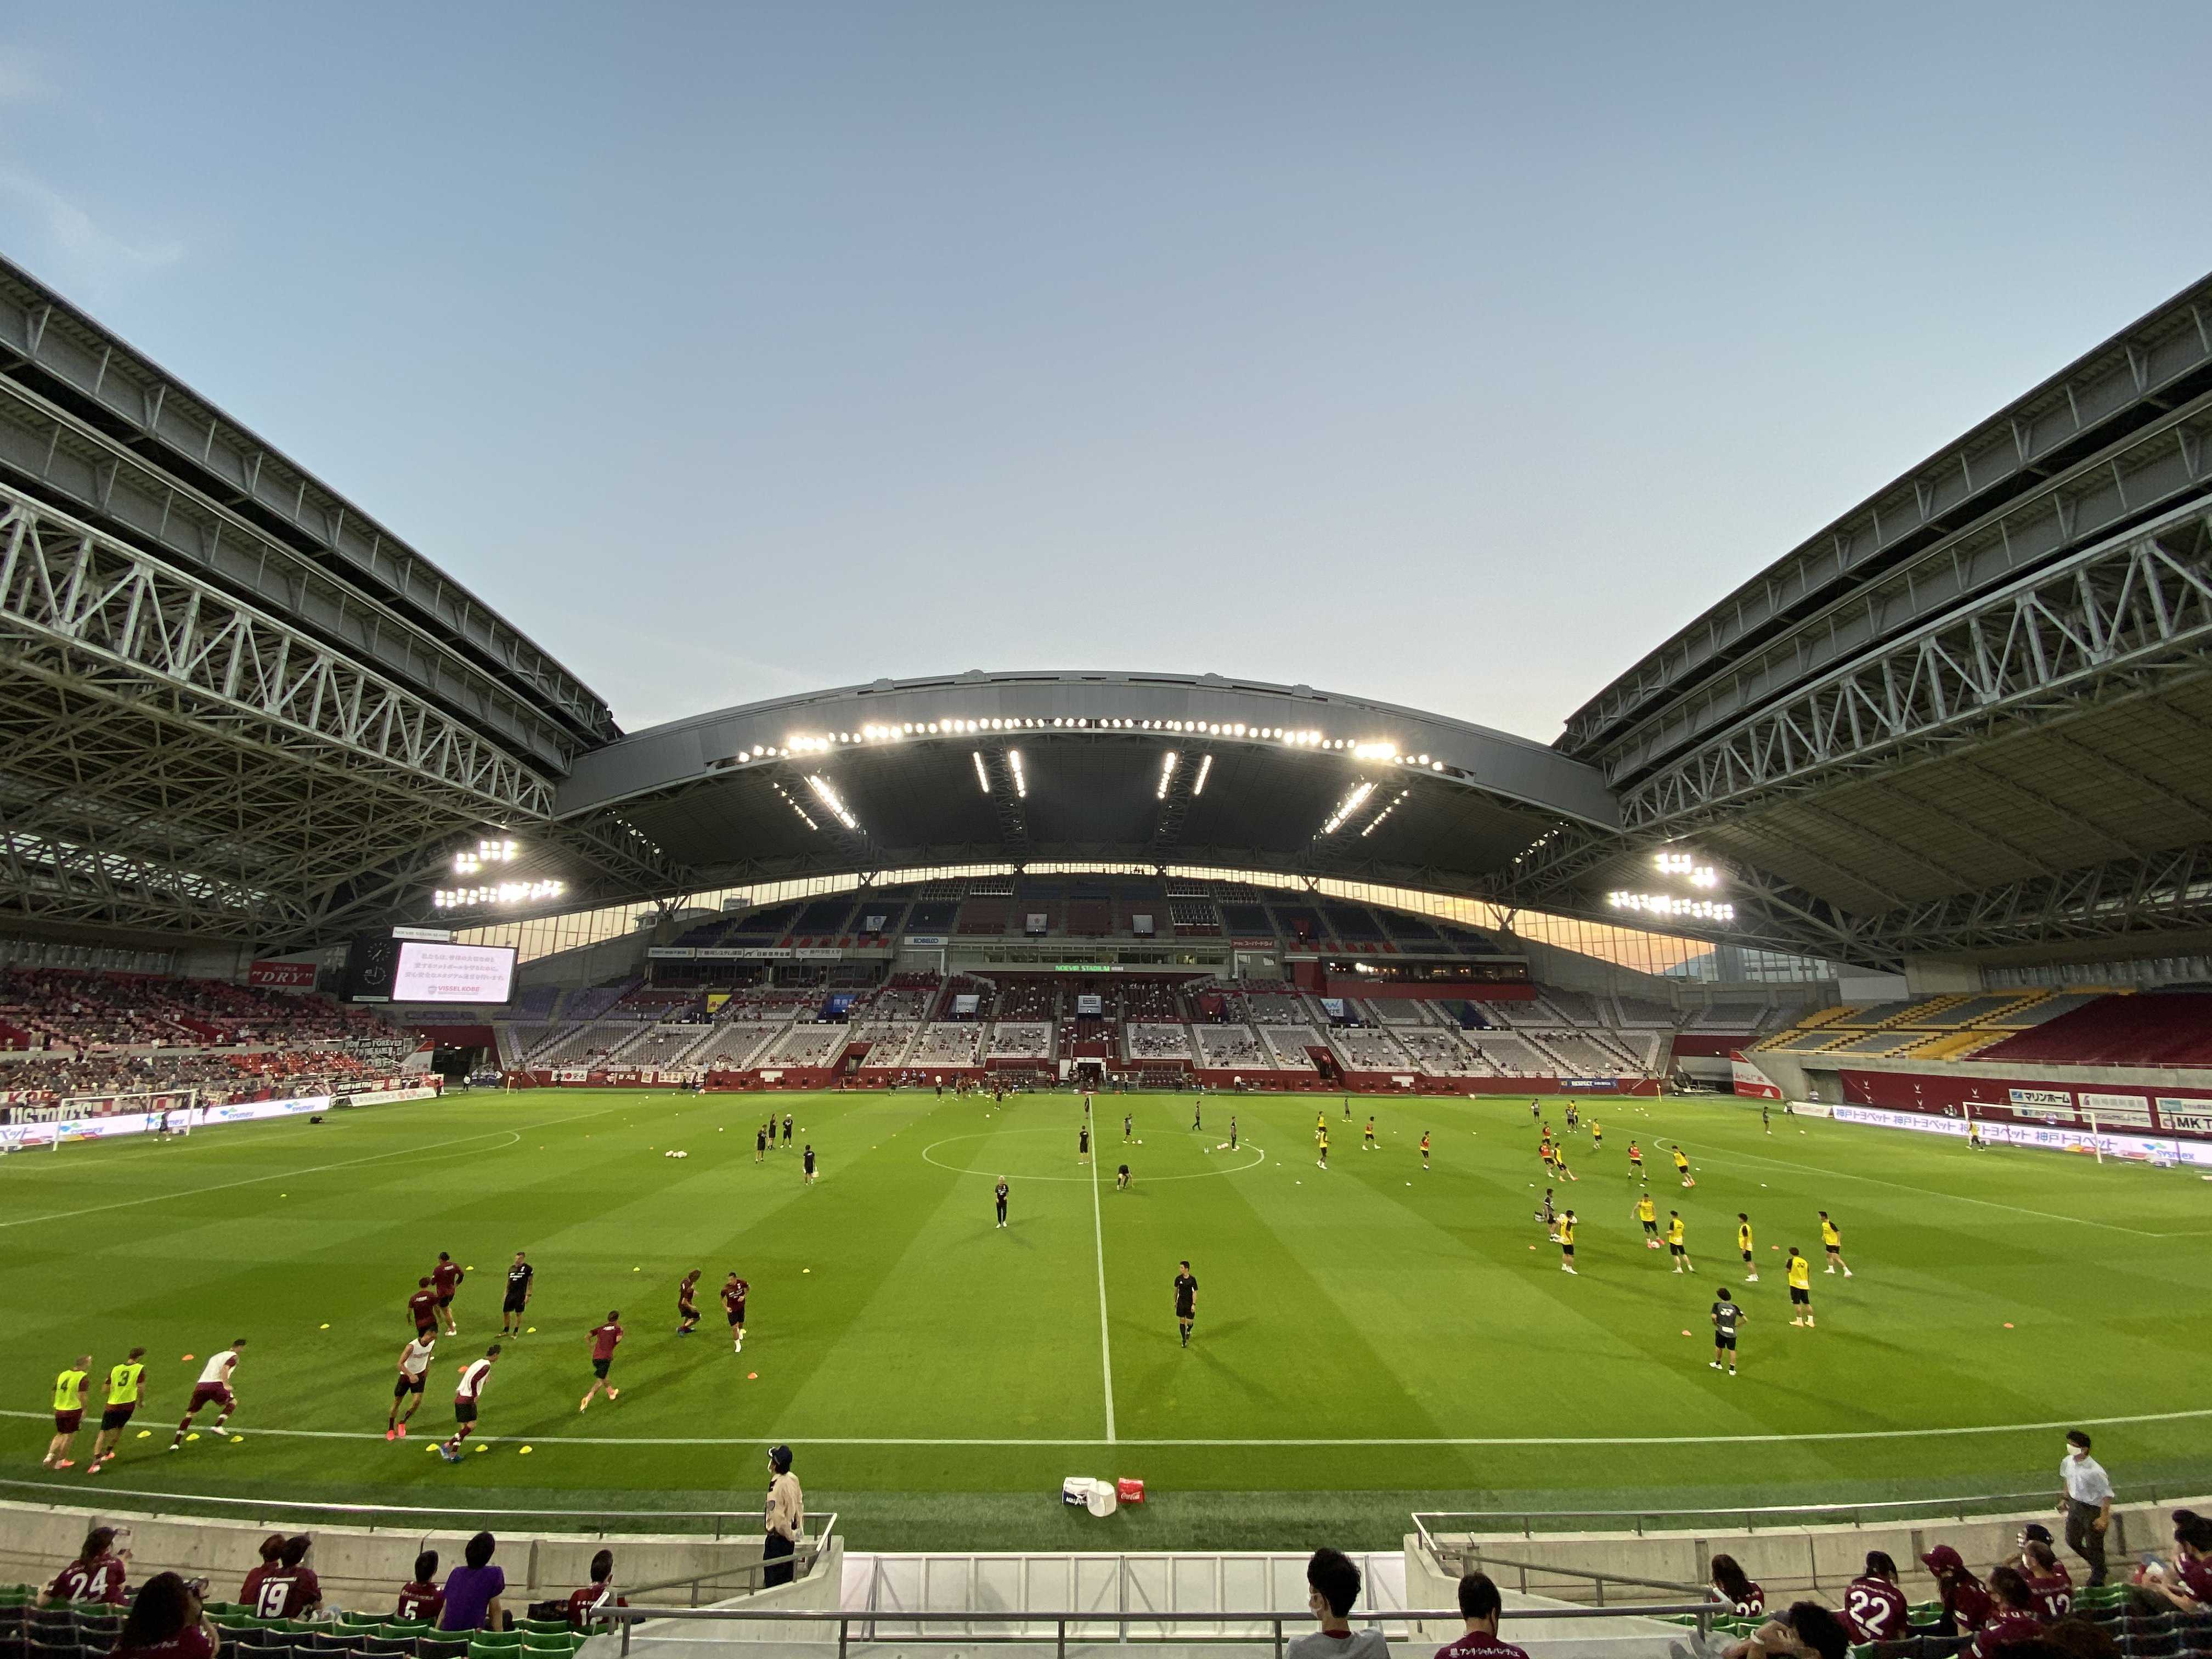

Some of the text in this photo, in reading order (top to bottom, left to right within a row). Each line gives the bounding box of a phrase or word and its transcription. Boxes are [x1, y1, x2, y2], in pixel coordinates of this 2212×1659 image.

[2023, 1092, 2070, 1103] マリンホーム
[1836, 1108, 1891, 1121] 神戸トヨペット
[1893, 1116, 1956, 1131] 神戸トヨペット
[2176, 1117, 2202, 1129] MK
[60, 1378, 69, 1392] 4
[118, 1370, 129, 1386] 3
[67, 1566, 108, 1605] 24
[257, 1583, 289, 1617] 19
[404, 1600, 419, 1620] 5
[1849, 1590, 1891, 1635] 22
